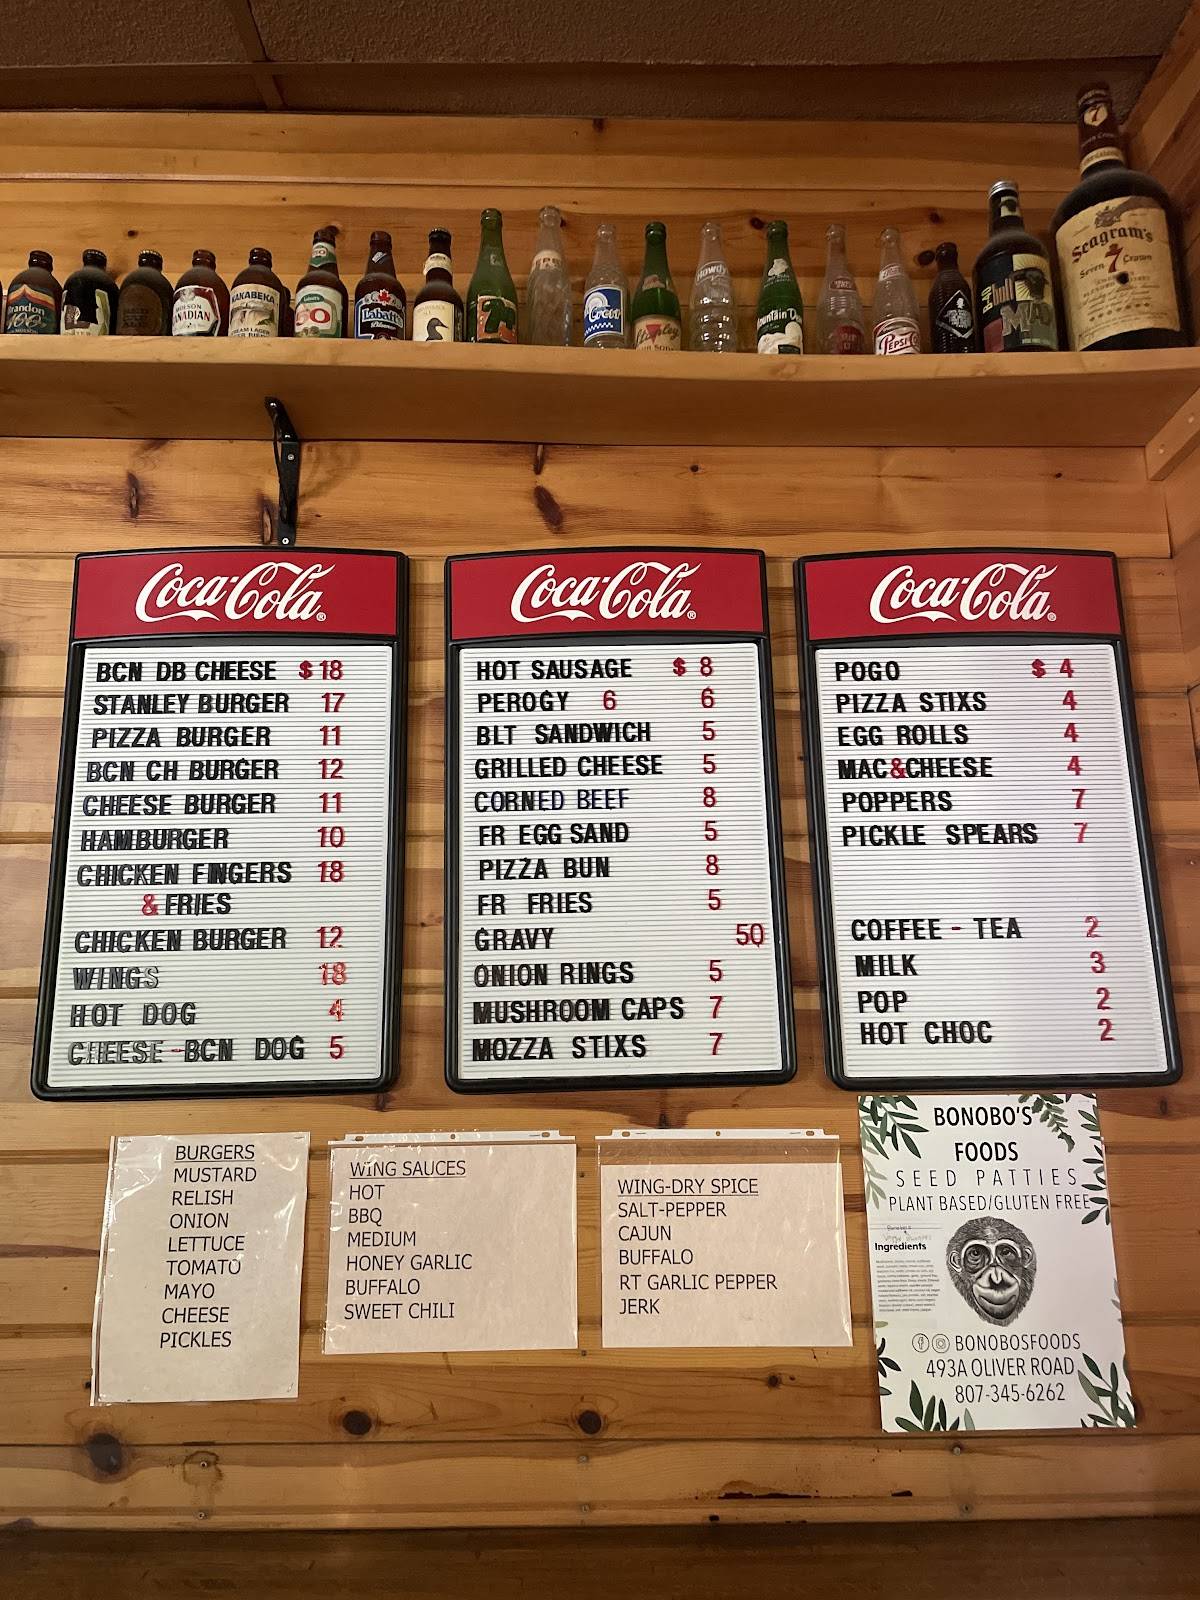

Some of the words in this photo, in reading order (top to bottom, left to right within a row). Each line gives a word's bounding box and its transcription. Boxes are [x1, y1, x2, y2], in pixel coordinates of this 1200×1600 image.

[1072, 226, 1153, 264] Seagram's
[1105, 243, 1124, 273] 7
[96, 662, 142, 682] BCN
[156, 661, 186, 681] DB
[195, 661, 277, 680] CHEESE
[476, 661, 520, 681] HOT
[531, 659, 632, 679] SAUSAGE
[835, 661, 900, 681] POGO
[93, 694, 189, 715] STANLEY
[198, 693, 289, 713] BURGER
[322, 693, 345, 712] 17
[478, 690, 569, 713] PEROGY
[603, 690, 616, 710] 6
[701, 687, 714, 708] 6
[836, 693, 906, 713] PIZZA
[919, 692, 986, 712] STIXS
[1062, 690, 1077, 710] 4
[92, 728, 161, 748] PIZZA
[177, 726, 271, 747] BURGER
[320, 726, 341, 746] 11
[476, 725, 516, 745] BLT
[535, 722, 650, 744] SANDWICH
[703, 721, 716, 741] 5
[838, 726, 883, 746] EGG
[897, 724, 969, 745] ROLLS
[1064, 723, 1079, 742] 4
[87, 761, 134, 782] BCN
[146, 760, 178, 781] CH
[189, 759, 279, 780] BURGER
[318, 759, 344, 779] 12
[475, 756, 567, 779] GRILLED
[577, 755, 662, 776] CHEESE
[703, 754, 716, 774] 5
[1067, 756, 1082, 775] 4
[83, 795, 173, 816] CHEESE
[184, 793, 276, 814] BURGER
[319, 793, 341, 813] 11
[474, 790, 564, 812] CORNED
[578, 788, 630, 810] BEEF
[703, 787, 716, 807] 8
[842, 791, 953, 812] POPPERS
[1072, 789, 1087, 809] 7
[81, 828, 229, 851] HAMBURGER
[318, 827, 345, 847] 10
[479, 826, 505, 846] FR
[519, 824, 562, 845] EGG
[570, 822, 629, 844] SAND
[705, 821, 718, 841] 5
[842, 825, 926, 846] PICKLE
[946, 823, 1038, 845] SPEARS
[77, 864, 179, 886] CHICKEN
[192, 862, 292, 885] FINGERS
[317, 861, 345, 882] 18
[479, 858, 548, 880] PIZZA
[564, 857, 610, 878] BUN
[706, 855, 719, 875] 8
[142, 894, 159, 916] &
[165, 893, 232, 915] FRIES
[478, 894, 506, 915] FR
[528, 892, 592, 914] FRIES
[708, 889, 721, 910] 5
[75, 930, 182, 953] CHICKEN
[193, 927, 287, 950] BURGER
[317, 926, 343, 948] 12
[474, 928, 554, 951] GRAVY
[851, 918, 942, 941] COFFEE
[973, 917, 1022, 939] TEA
[474, 964, 548, 987] ONION
[560, 962, 634, 984] RINGS
[710, 960, 723, 982] 5
[855, 954, 918, 976] MILK
[1090, 951, 1105, 973] 3
[72, 966, 159, 990] WINGS
[473, 998, 610, 1024] MUSHROOM
[622, 996, 684, 1020] CAPS
[710, 996, 724, 1018] 7
[858, 991, 907, 1013] POP
[1096, 987, 1113, 1010] 2
[70, 1004, 122, 1027] HOT
[142, 1002, 196, 1025] DOG
[860, 1022, 907, 1045] HOT
[924, 1021, 993, 1044] CHOC
[1098, 1019, 1115, 1041] 2
[255, 1036, 304, 1060] DOG
[329, 1036, 344, 1059] 5
[472, 1037, 553, 1061] MOZZA
[572, 1034, 646, 1059] STIXS
[710, 1033, 724, 1055] 7
[934, 1106, 1033, 1126] BONOBO'S
[175, 1144, 255, 1160] BURGERS
[954, 1142, 1019, 1162] FOODS
[174, 1168, 257, 1183] MUSTARD
[350, 1162, 397, 1177] WING
[402, 1160, 466, 1176] SAUCES
[896, 1169, 957, 1187] SEED
[976, 1168, 1077, 1187] PATTIES
[349, 1185, 385, 1200] HOT
[618, 1179, 705, 1194] WING-DRY
[711, 1179, 759, 1193] SPICE
[172, 1190, 234, 1205] RELISH
[889, 1196, 933, 1211] PLANT
[940, 1196, 1049, 1211] BASED/GLUTEN
[1056, 1195, 1091, 1209] FREE
[169, 1213, 229, 1228] ONION
[348, 1208, 382, 1226] BBQ
[618, 1202, 727, 1218] SALT-PEPPER
[168, 1236, 245, 1252] LETTUCE
[347, 1232, 417, 1247] MEDIUM
[618, 1226, 672, 1241] CAJUN
[619, 1249, 693, 1264] BUFFALO
[875, 1242, 927, 1252] Ingredients
[166, 1259, 241, 1275] TOMATO
[346, 1255, 404, 1271] HONEY
[410, 1254, 472, 1270] GARLIC
[164, 1283, 215, 1299] MAYO
[345, 1279, 420, 1295] BUFFALO
[620, 1275, 641, 1289] RT
[647, 1275, 709, 1289] GARLIC
[715, 1275, 777, 1289] PEPPER
[162, 1307, 229, 1324] CHEESE
[344, 1303, 402, 1320] SWEET
[408, 1302, 455, 1319] CHILI
[619, 1299, 660, 1314] JERK
[160, 1331, 232, 1348] PICKLES
[955, 1333, 1081, 1351] BONOBOSFOODS
[926, 1359, 967, 1377] 493A
[971, 1358, 1026, 1376] OLIVER
[1031, 1357, 1075, 1375] ROAD
[955, 1383, 1065, 1403] 807-345-6262
